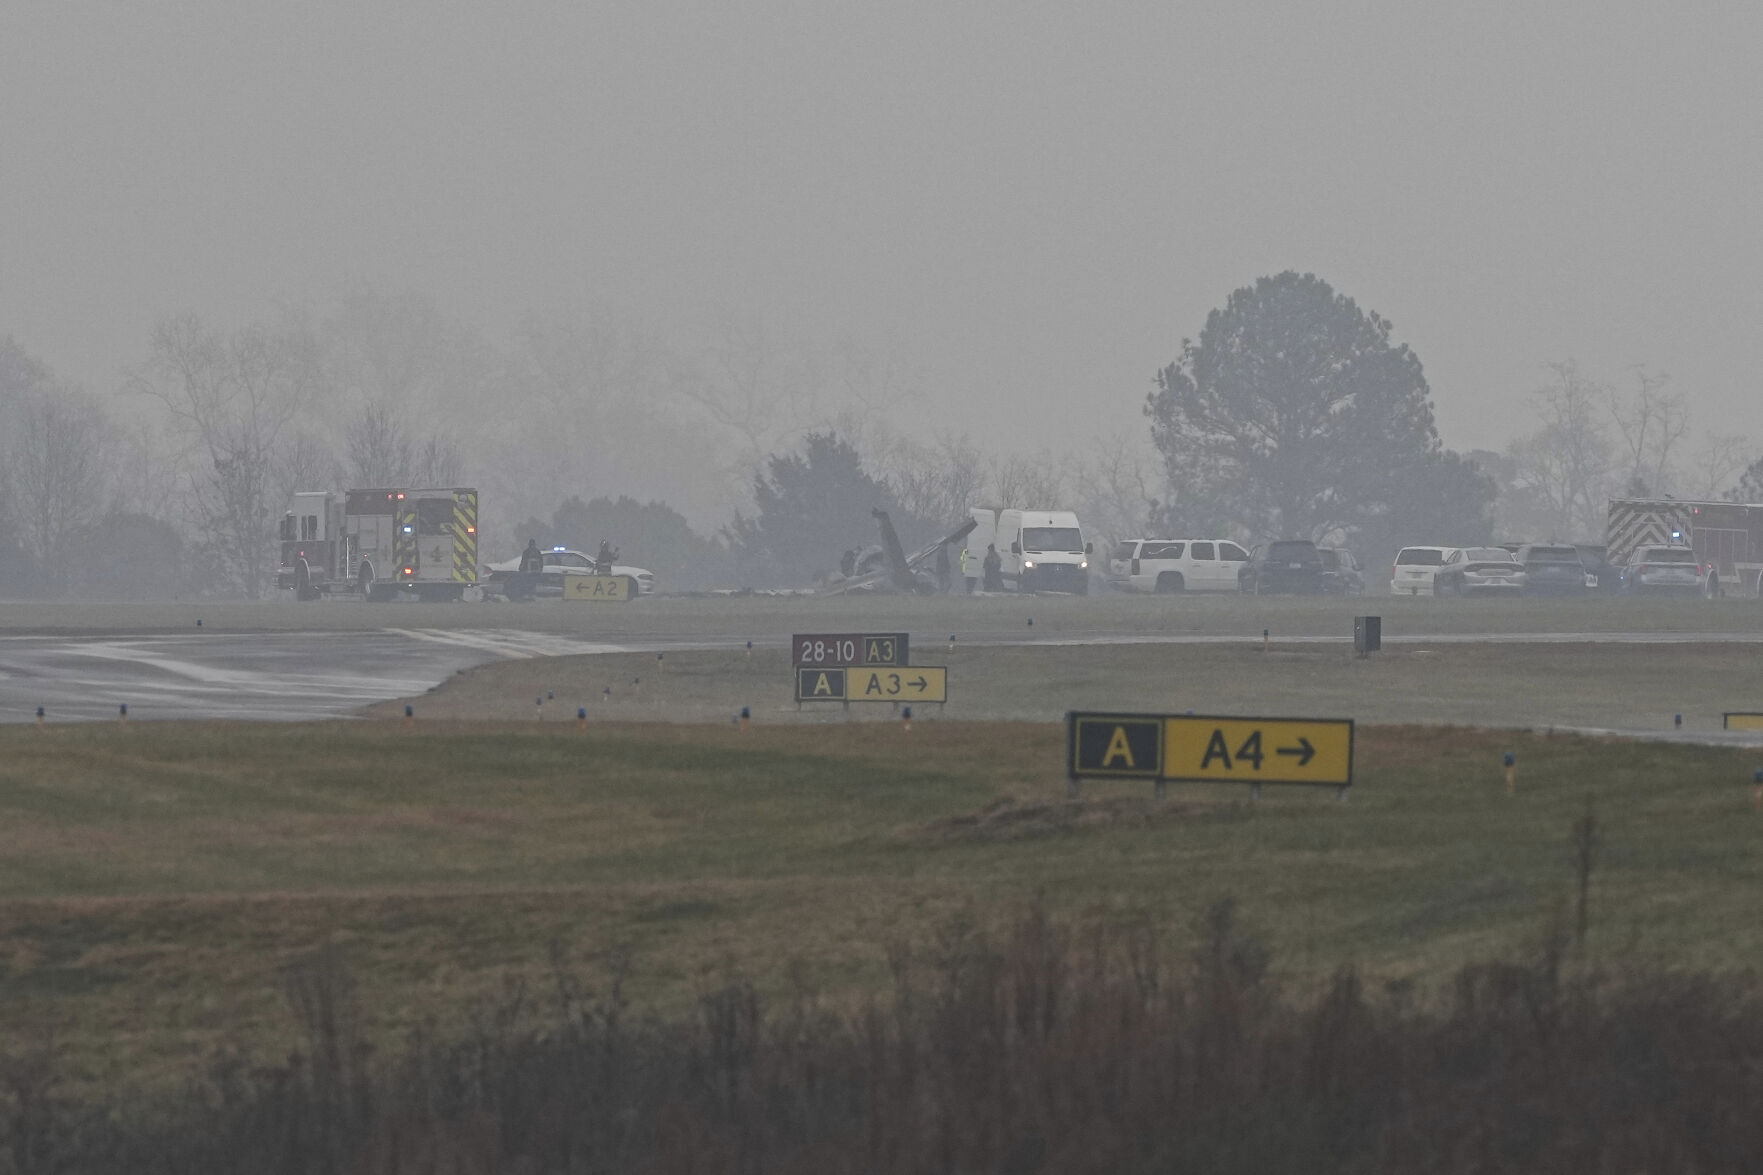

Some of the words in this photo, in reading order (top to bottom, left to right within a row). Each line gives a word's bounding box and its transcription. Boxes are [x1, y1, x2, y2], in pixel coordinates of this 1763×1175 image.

[593, 581, 617, 596] A2
[802, 640, 855, 662] 28-10
[868, 641, 893, 661] A3
[814, 672, 831, 695] A
[866, 673, 901, 695] A3
[1103, 726, 1134, 766] A
[1200, 729, 1264, 770] A4
